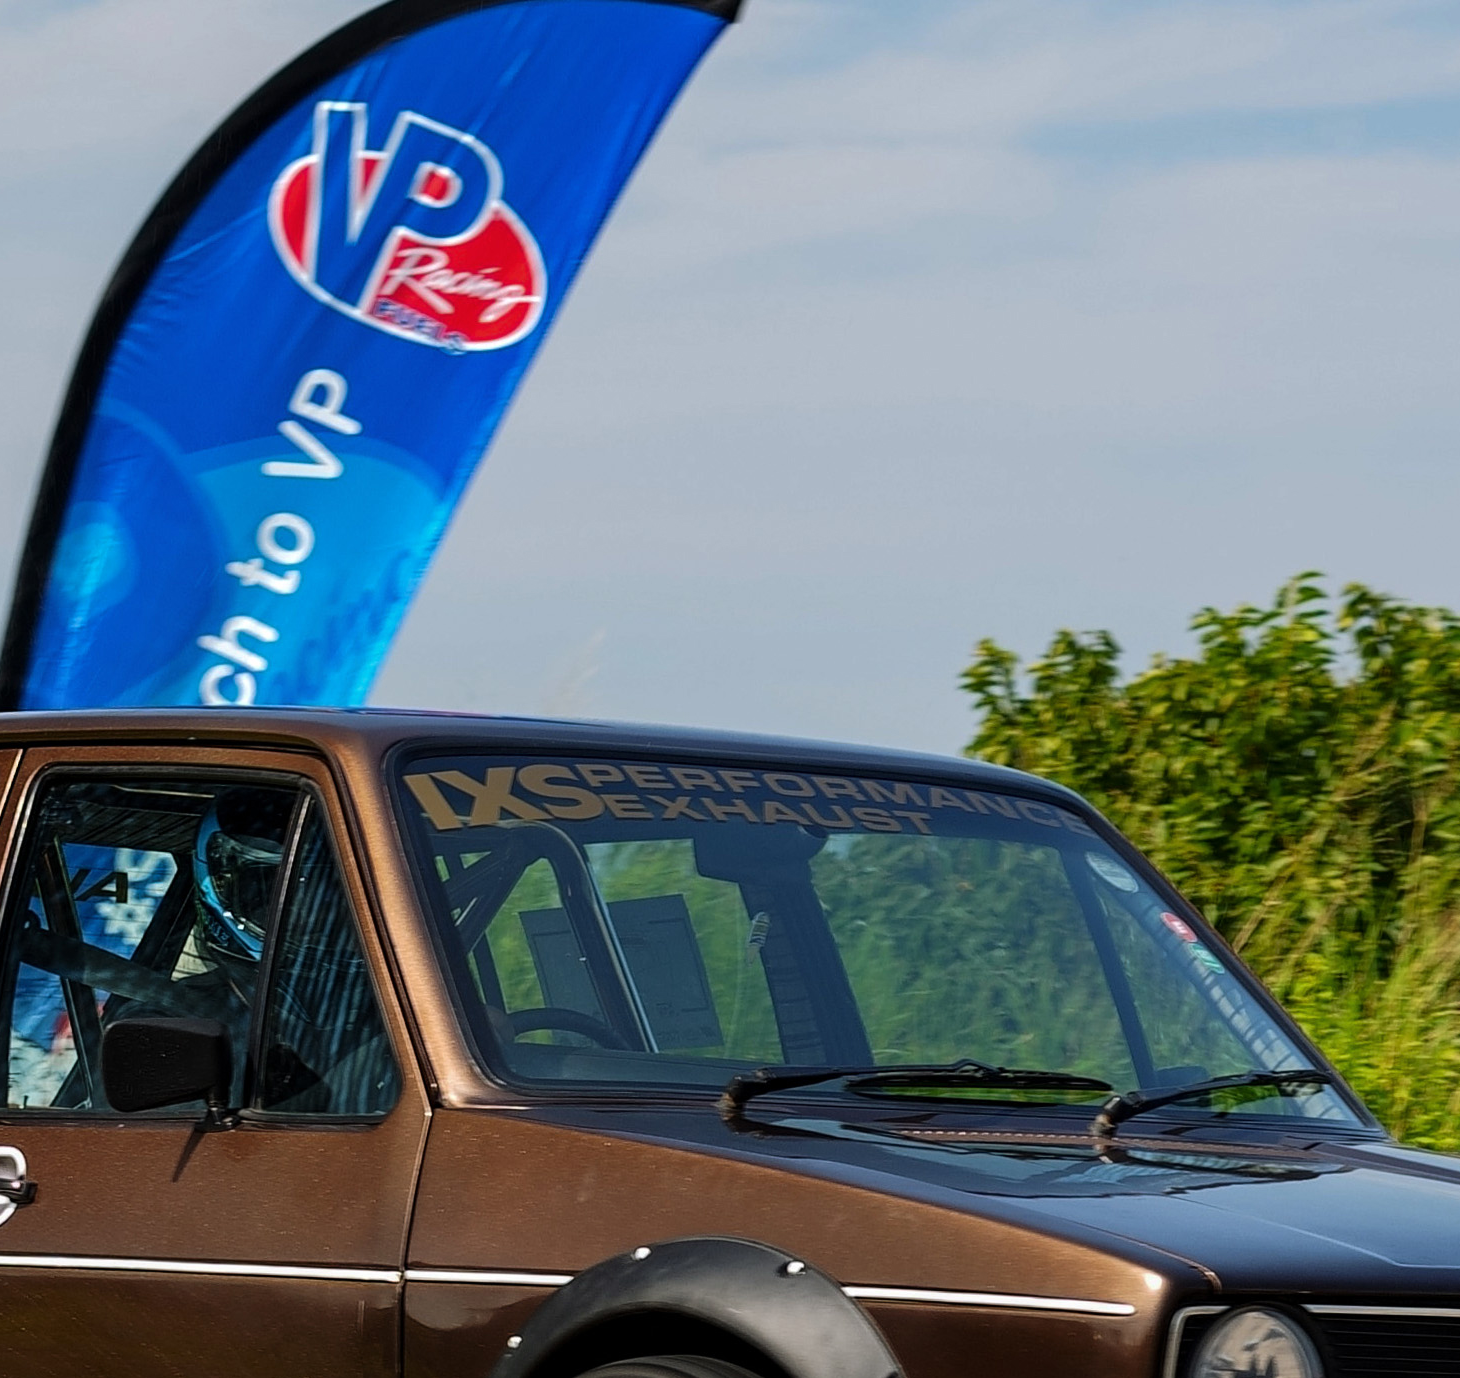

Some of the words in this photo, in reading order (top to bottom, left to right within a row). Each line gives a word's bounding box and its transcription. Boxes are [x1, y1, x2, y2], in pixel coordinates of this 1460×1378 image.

[304, 101, 504, 316] VP
[382, 246, 542, 323] Racing
[261, 368, 363, 479] VP
[225, 512, 316, 595] to
[402, 764, 607, 831] IXS
[601, 794, 933, 835] EXHAUST
